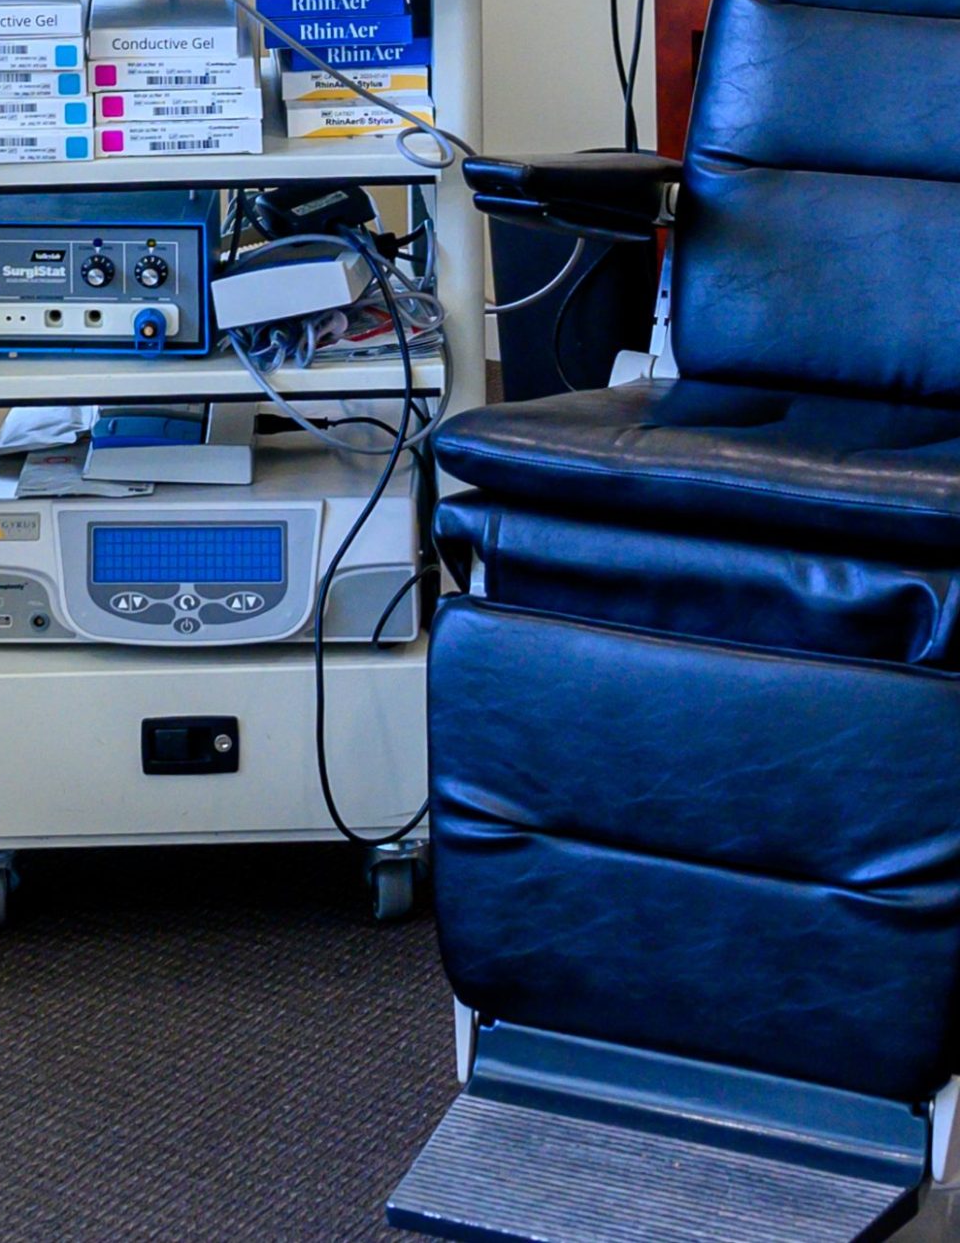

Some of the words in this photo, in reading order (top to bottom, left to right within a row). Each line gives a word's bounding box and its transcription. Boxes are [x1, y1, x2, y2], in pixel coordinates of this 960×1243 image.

[35, 15, 58, 27] Gel
[300, 22, 379, 40] RhinAer
[111, 38, 188, 51] Conductive
[192, 37, 214, 49] Gel
[327, 45, 404, 64] RhinAer
[357, 80, 382, 89] Stylus
[368, 117, 394, 126] Stylus
[2, 265, 66, 279] SurgiStat
